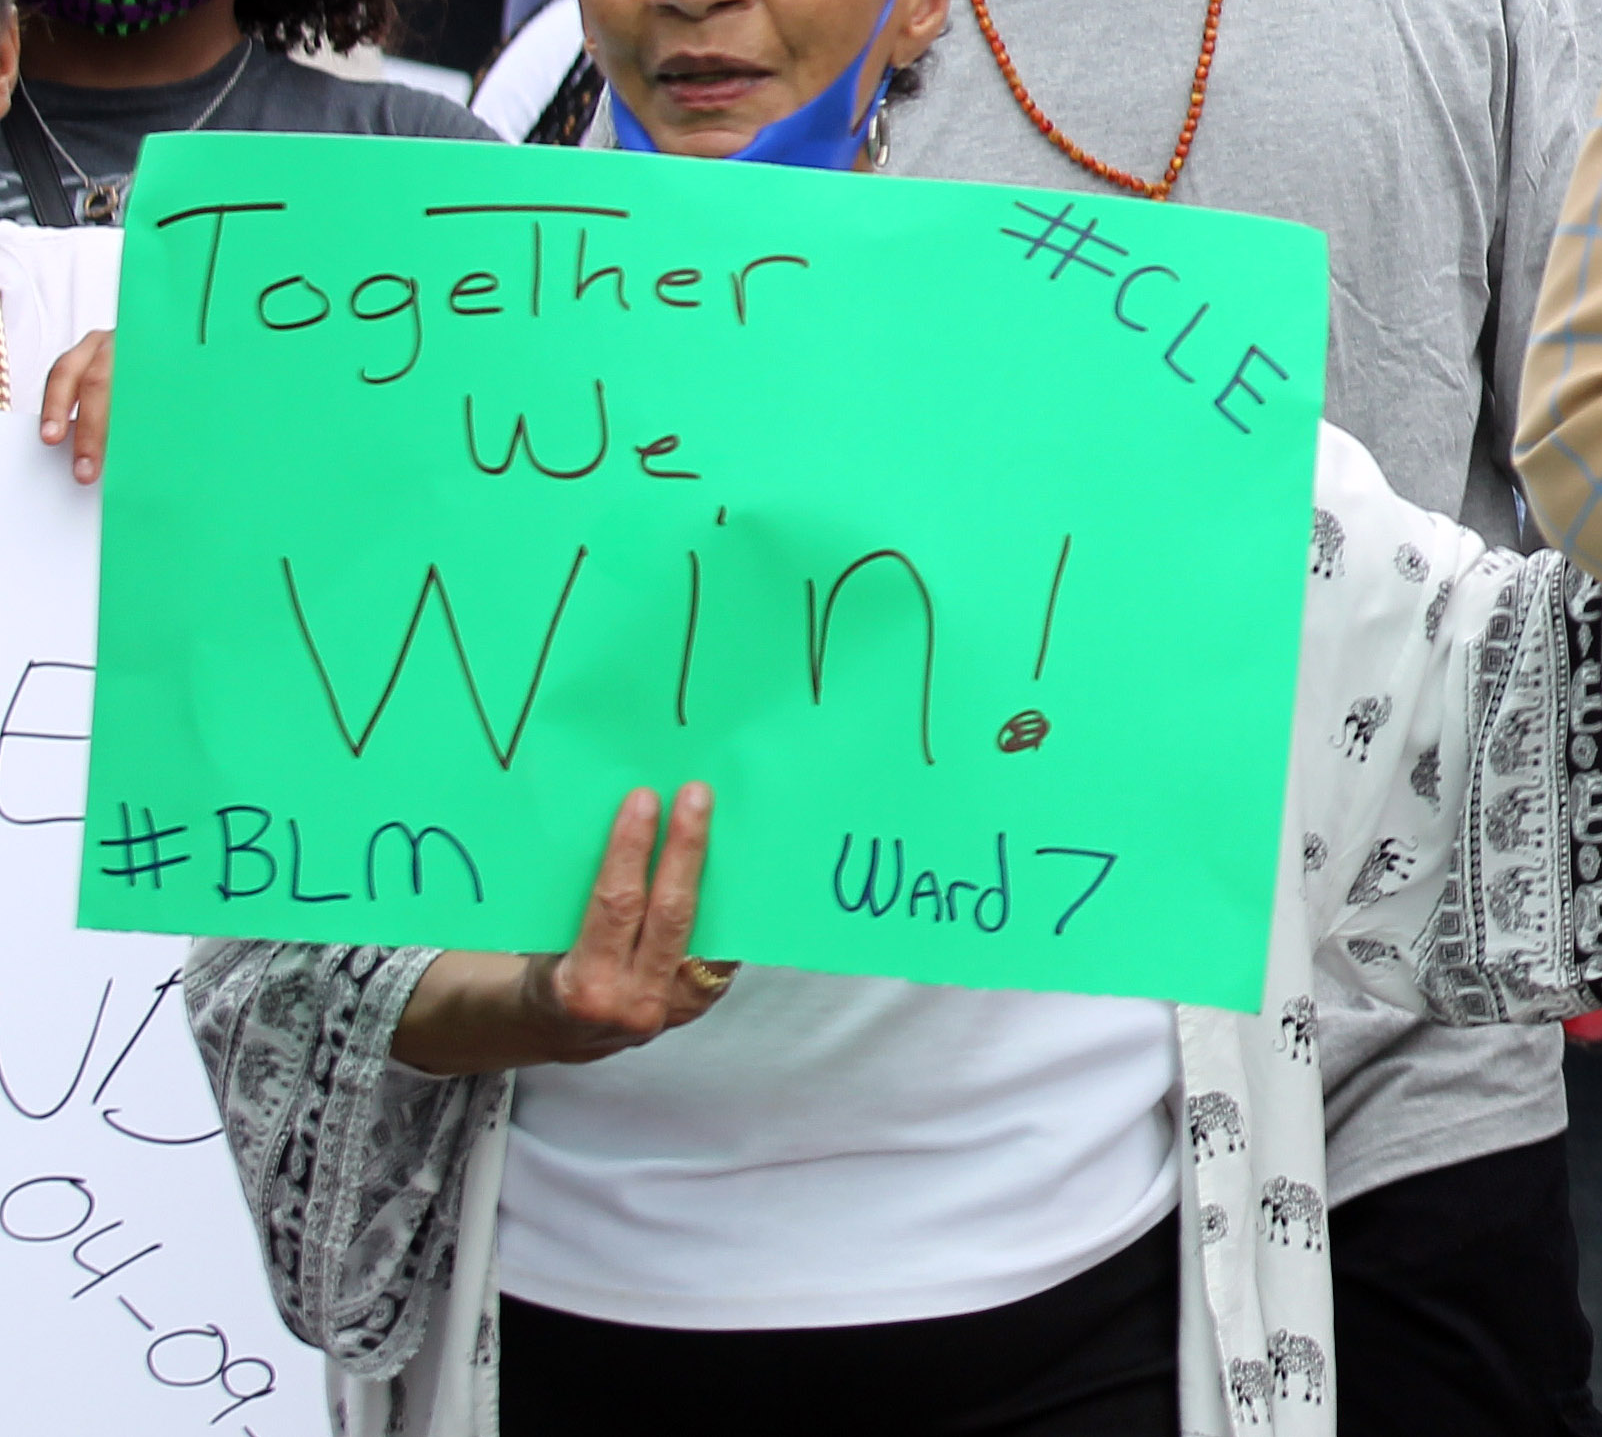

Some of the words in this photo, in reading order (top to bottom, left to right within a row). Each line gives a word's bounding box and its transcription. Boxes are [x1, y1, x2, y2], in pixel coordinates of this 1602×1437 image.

[156, 202, 809, 384] Together
[999, 201, 1289, 435] #CLE
[465, 378, 702, 481] We
[282, 504, 1072, 771] Win!
[1034, 846, 1119, 936] 7
